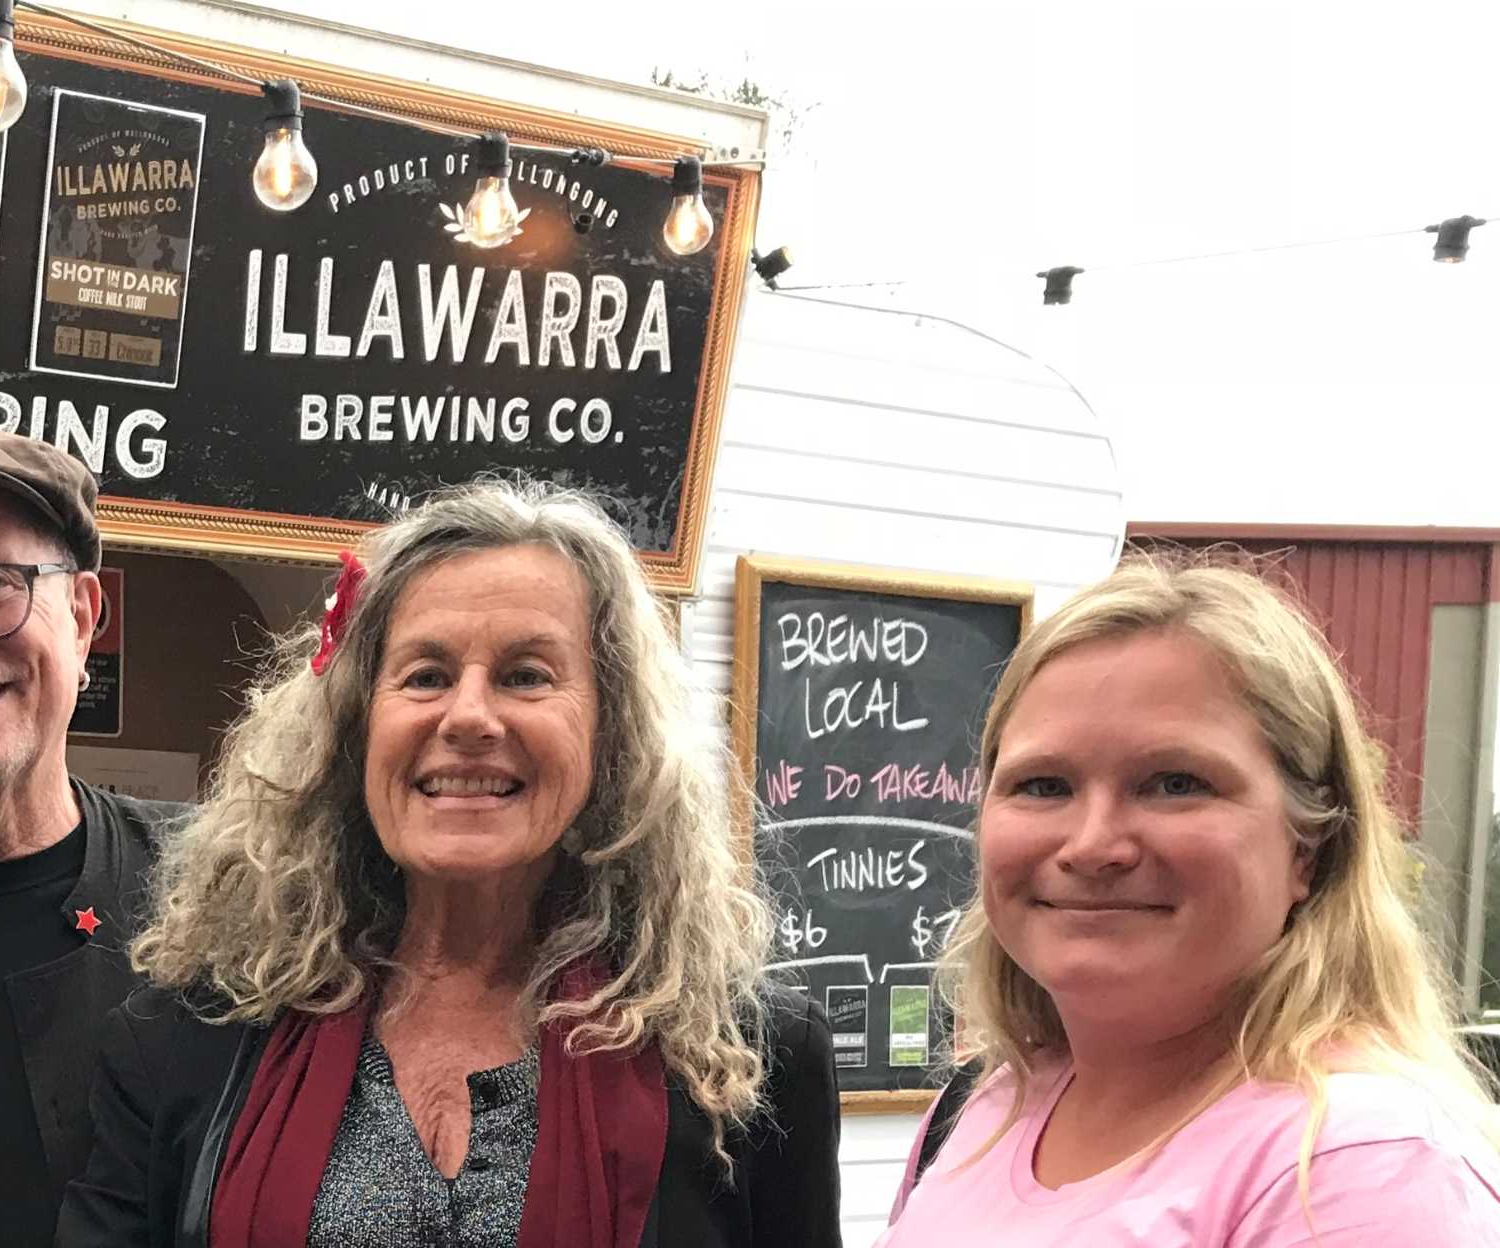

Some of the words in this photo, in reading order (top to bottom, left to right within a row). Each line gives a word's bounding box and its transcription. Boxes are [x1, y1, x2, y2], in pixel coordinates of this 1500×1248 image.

[56, 158, 195, 196] ILLAWARRA
[329, 156, 428, 214] PRODUCT
[445, 153, 470, 176] OF
[506, 157, 619, 229] OLLONGONG
[76, 200, 151, 220] BREWING
[155, 197, 182, 213] CO.
[50, 260, 105, 286] SHOT
[107, 268, 120, 281] IN
[123, 271, 179, 297] DARK
[78, 287, 104, 305] COFFEE
[106, 290, 124, 307] MILK
[126, 294, 148, 312] STOUT
[244, 248, 672, 374] ILLAWARRA
[300, 394, 531, 443] BREWING
[548, 397, 625, 443] CO.
[367, 481, 412, 512] HAND
[777, 611, 928, 671] BREWED
[805, 677, 930, 739] LOCAL
[765, 759, 804, 808] WE
[870, 758, 983, 804] TAKEAWA
[807, 839, 928, 892] TINNIES
[780, 907, 828, 954] $6
[911, 905, 962, 959] $7
